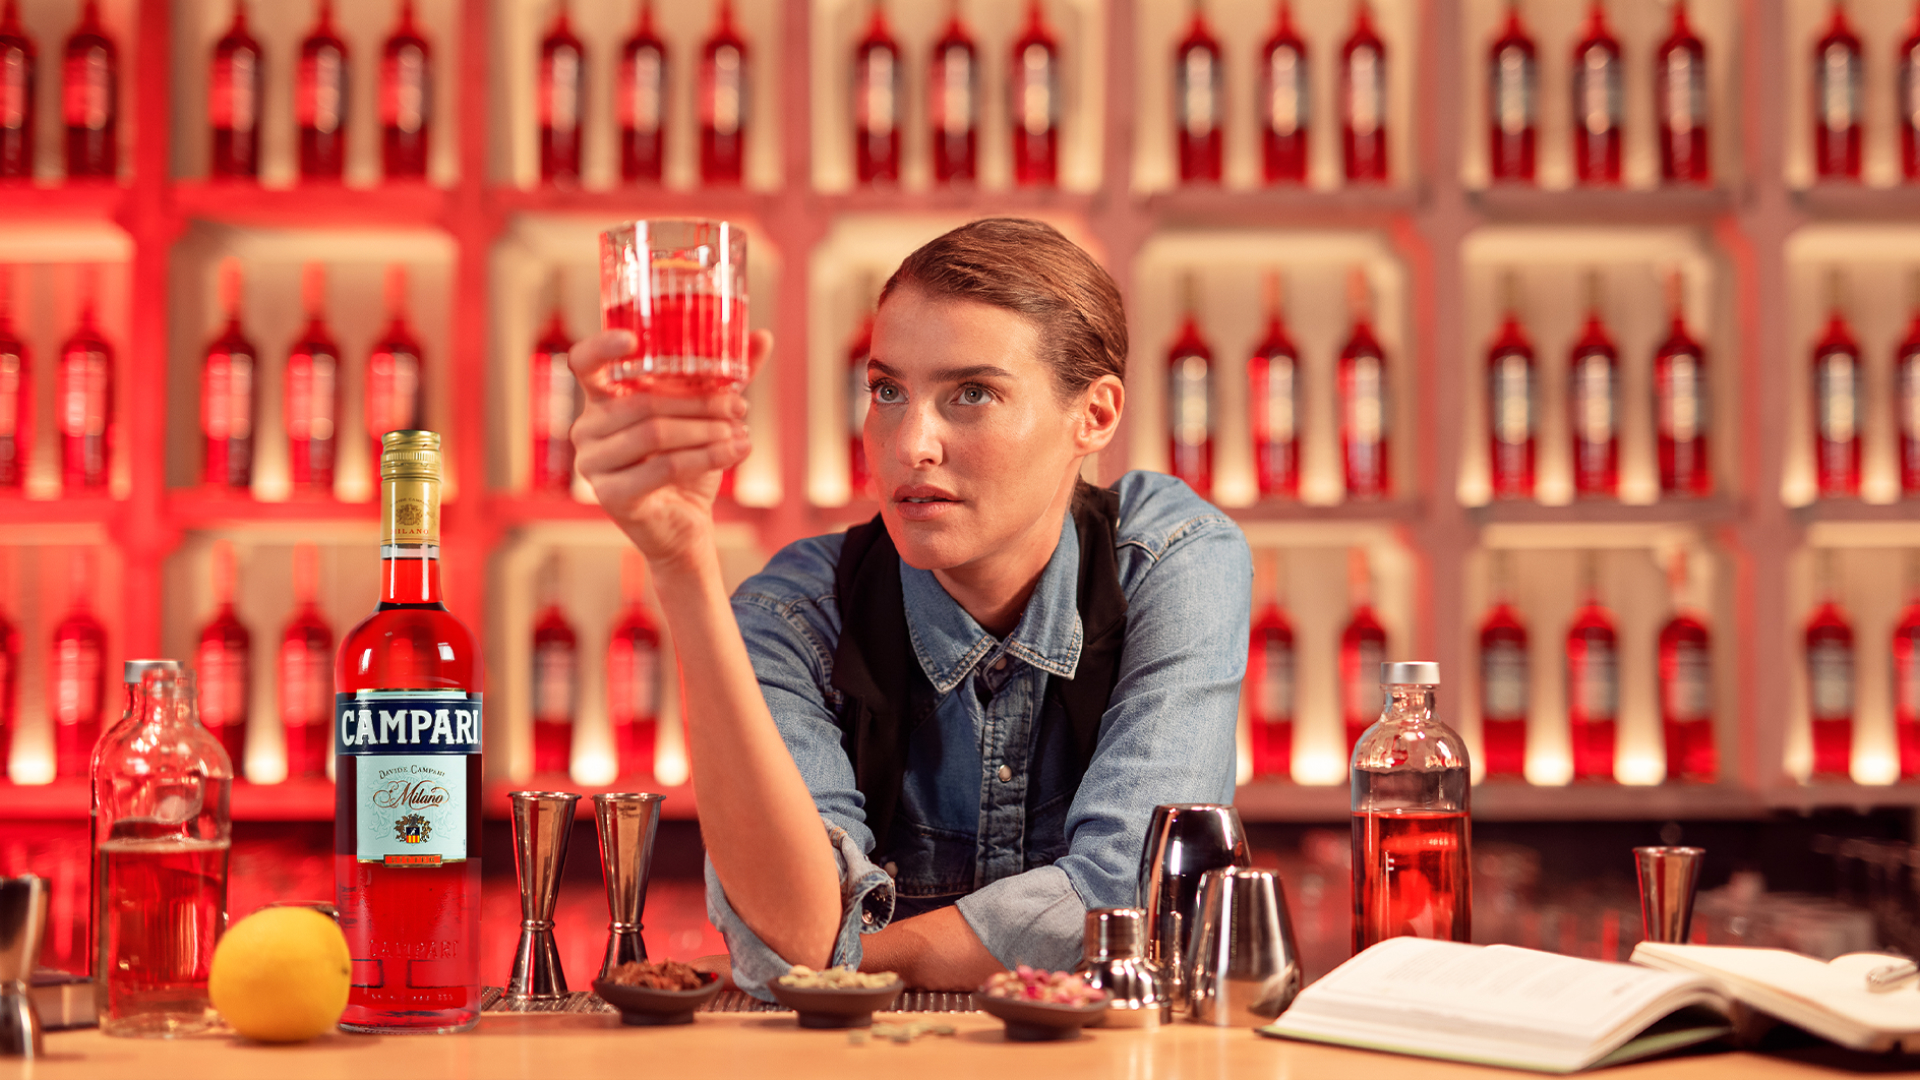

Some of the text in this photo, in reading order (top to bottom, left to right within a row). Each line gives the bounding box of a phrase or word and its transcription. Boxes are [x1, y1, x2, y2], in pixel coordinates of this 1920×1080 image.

[341, 709, 479, 747] CAMPARI
[373, 779, 451, 811] Milano
[369, 939, 460, 959] CAMPARI
